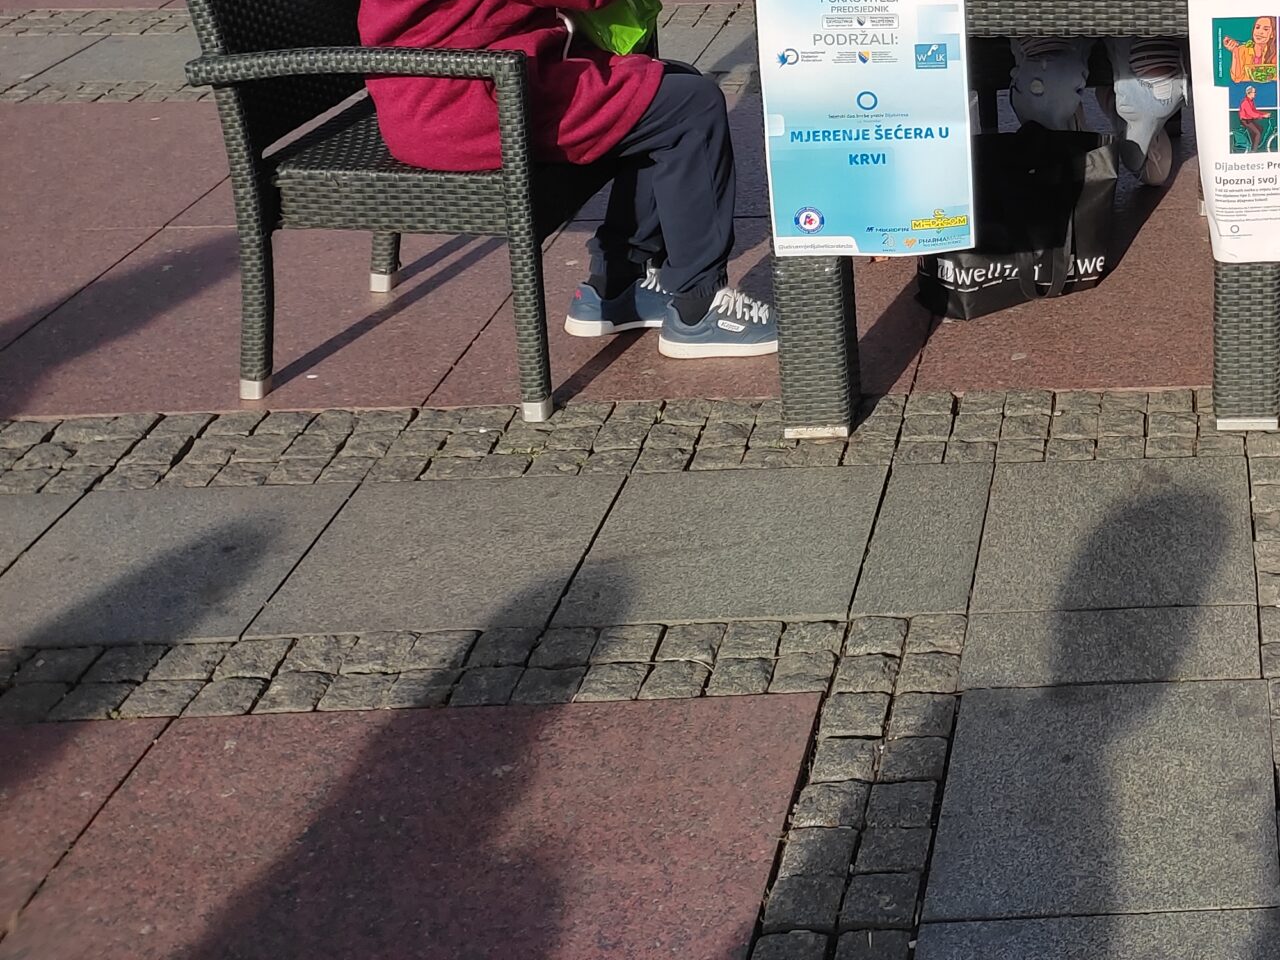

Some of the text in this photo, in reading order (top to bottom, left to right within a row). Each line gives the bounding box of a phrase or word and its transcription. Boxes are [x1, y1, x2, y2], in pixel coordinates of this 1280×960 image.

[830, 5, 889, 13] PREDSJEDNIK
[813, 29, 899, 46] PODRŽALI:
[790, 124, 949, 143] MJERENJE ŠEĆERA U
[849, 153, 886, 166] KRVI
[1215, 161, 1264, 172] Dijabetes:
[1215, 175, 1255, 186] Upoznaj
[1258, 174, 1278, 185] svoj
